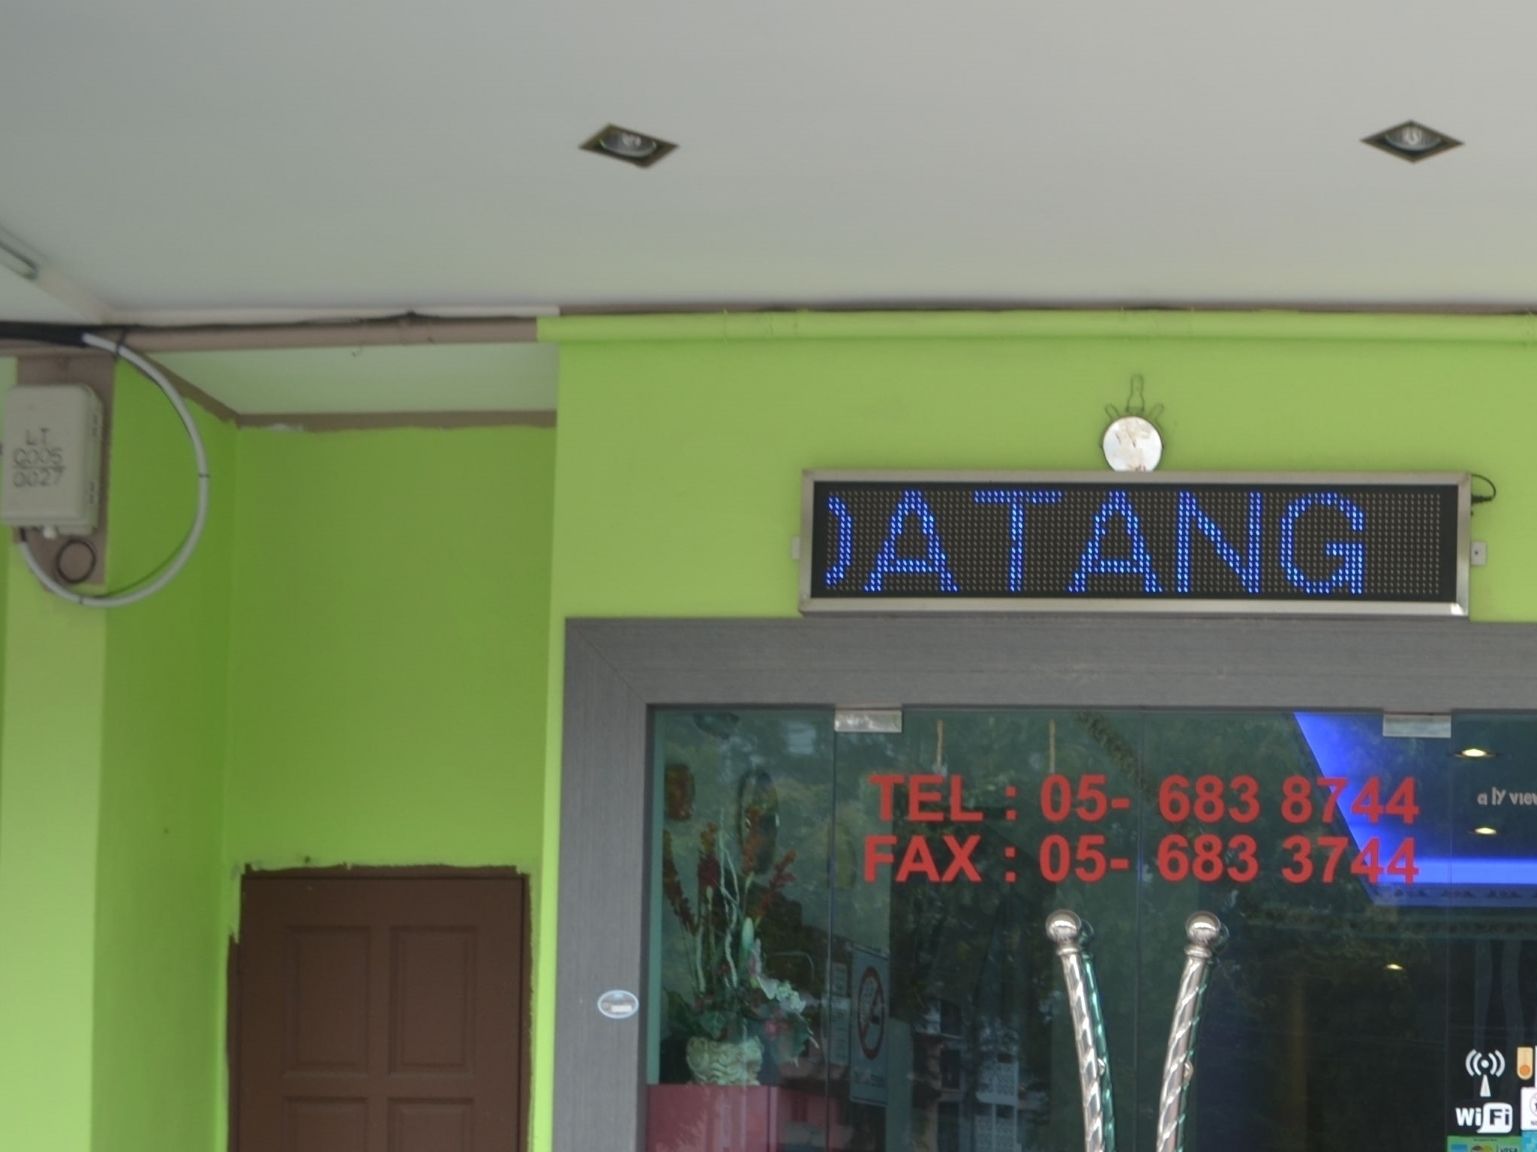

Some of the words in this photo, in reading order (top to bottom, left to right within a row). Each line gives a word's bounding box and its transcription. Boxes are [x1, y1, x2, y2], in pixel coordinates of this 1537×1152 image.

[870, 775, 983, 822] TEL
[1040, 775, 1130, 822] 05-
[1159, 775, 1260, 823] 683
[1282, 775, 1420, 824] 8744
[864, 834, 982, 882] FAX
[1040, 834, 1130, 883] 05-
[1158, 834, 1260, 883] 683
[1282, 834, 1420, 885] 3744
